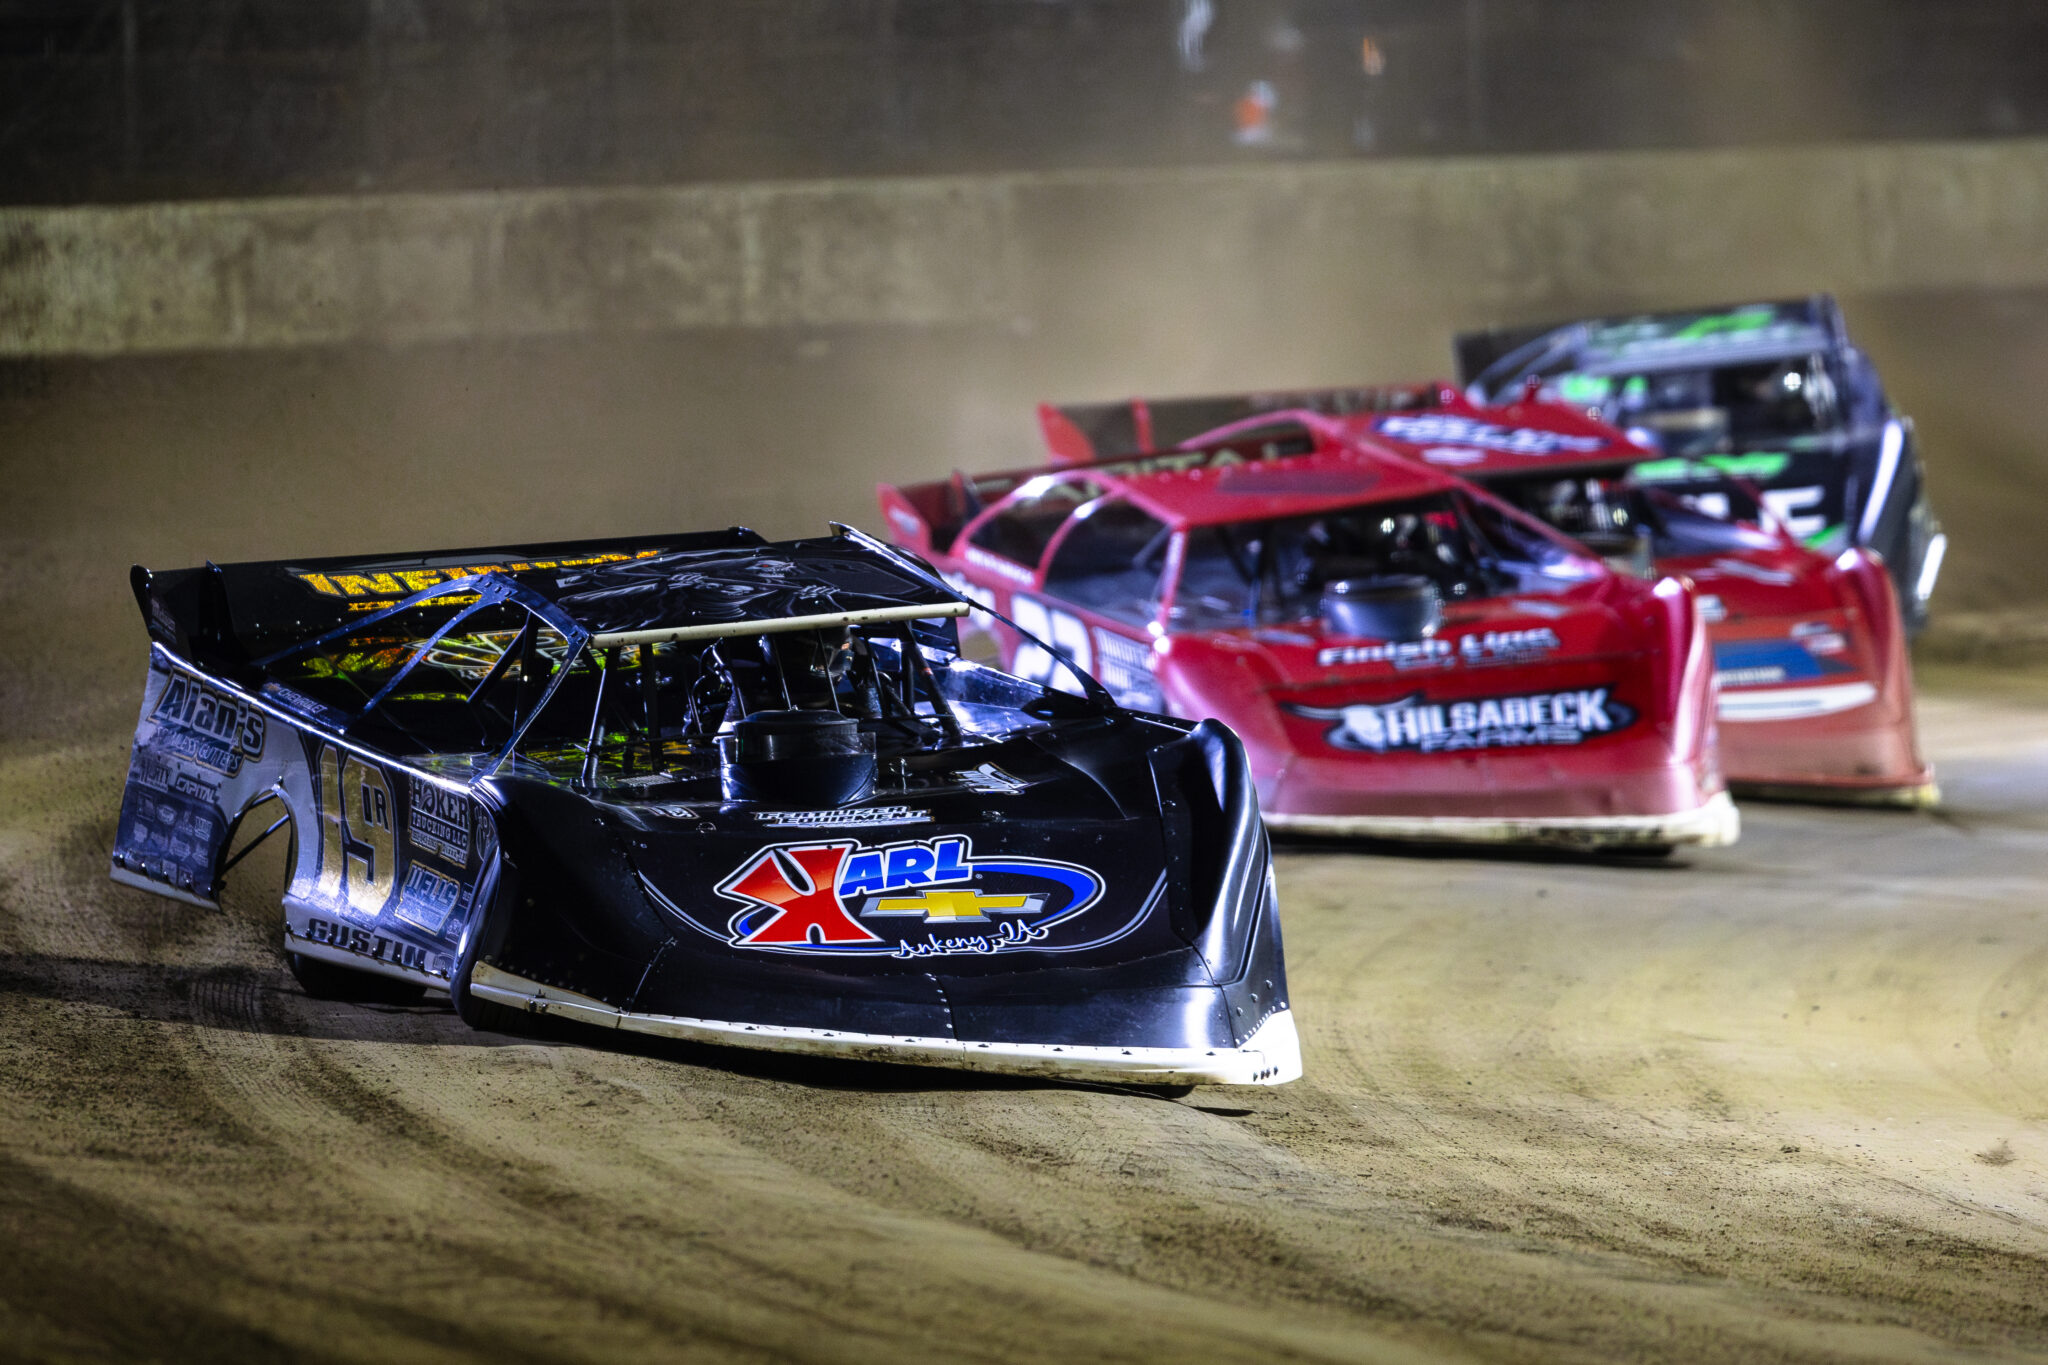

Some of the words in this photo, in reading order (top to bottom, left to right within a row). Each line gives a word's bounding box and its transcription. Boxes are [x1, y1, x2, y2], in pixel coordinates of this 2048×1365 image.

[153, 674, 263, 756] Alan's
[1386, 688, 1612, 746] HILSABECK
[198, 742, 241, 770] GUTTERS
[175, 776, 216, 804] CAPITAL
[412, 811, 451, 840] TRUCKING
[452, 829, 469, 848] LLC
[776, 810, 931, 825] EQUIPMENT
[720, 839, 973, 946] KARL
[308, 917, 426, 970] GUSTIN
